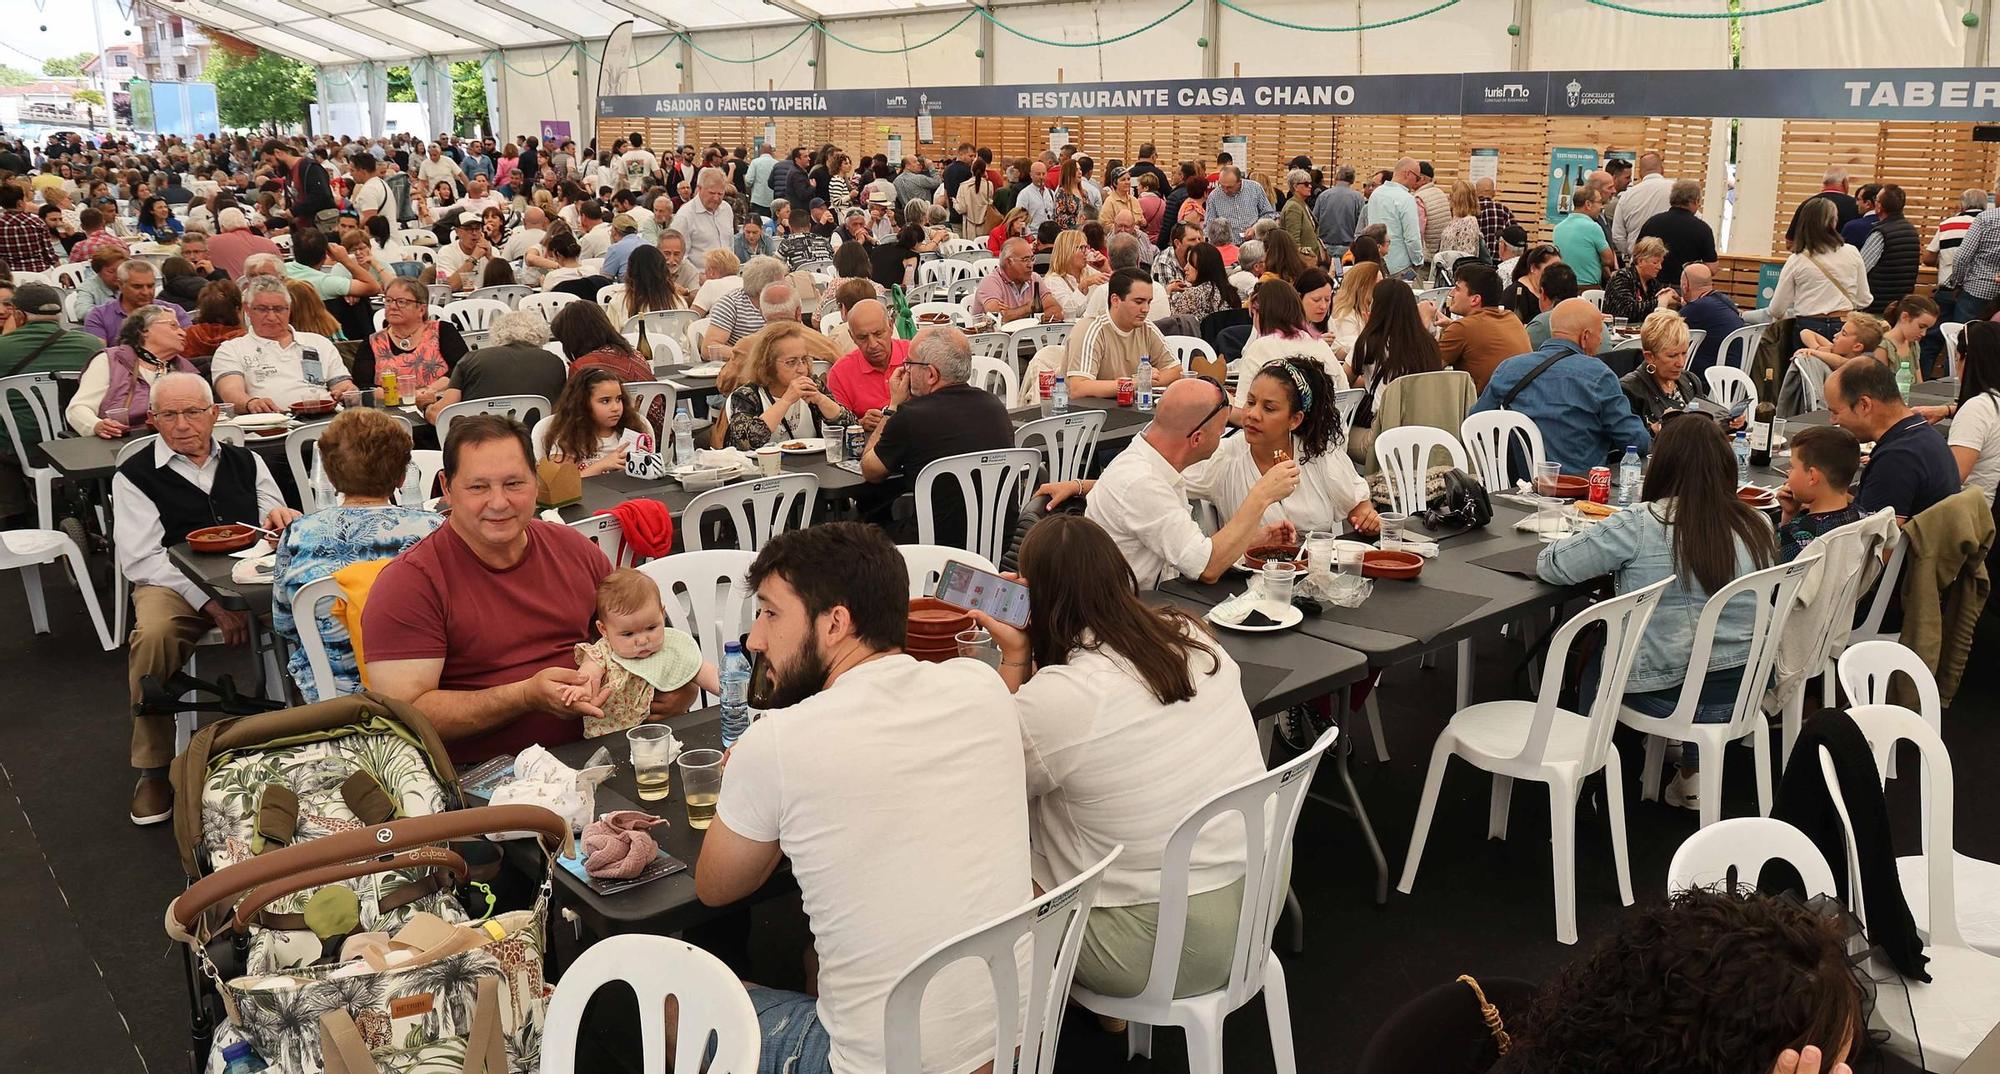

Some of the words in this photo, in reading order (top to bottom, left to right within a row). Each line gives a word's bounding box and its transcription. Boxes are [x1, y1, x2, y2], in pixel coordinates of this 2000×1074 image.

[655, 97, 702, 112] ASADOR
[705, 97, 714, 112] O
[718, 96, 767, 112] FANECO
[770, 92, 828, 111] TAPERÍA
[1018, 89, 1168, 109] RESTAURANTE
[1178, 86, 1246, 107] CASA
[1255, 85, 1355, 105] CHANO
[1844, 81, 2000, 107] TABER
[420, 849, 447, 860] cybex
